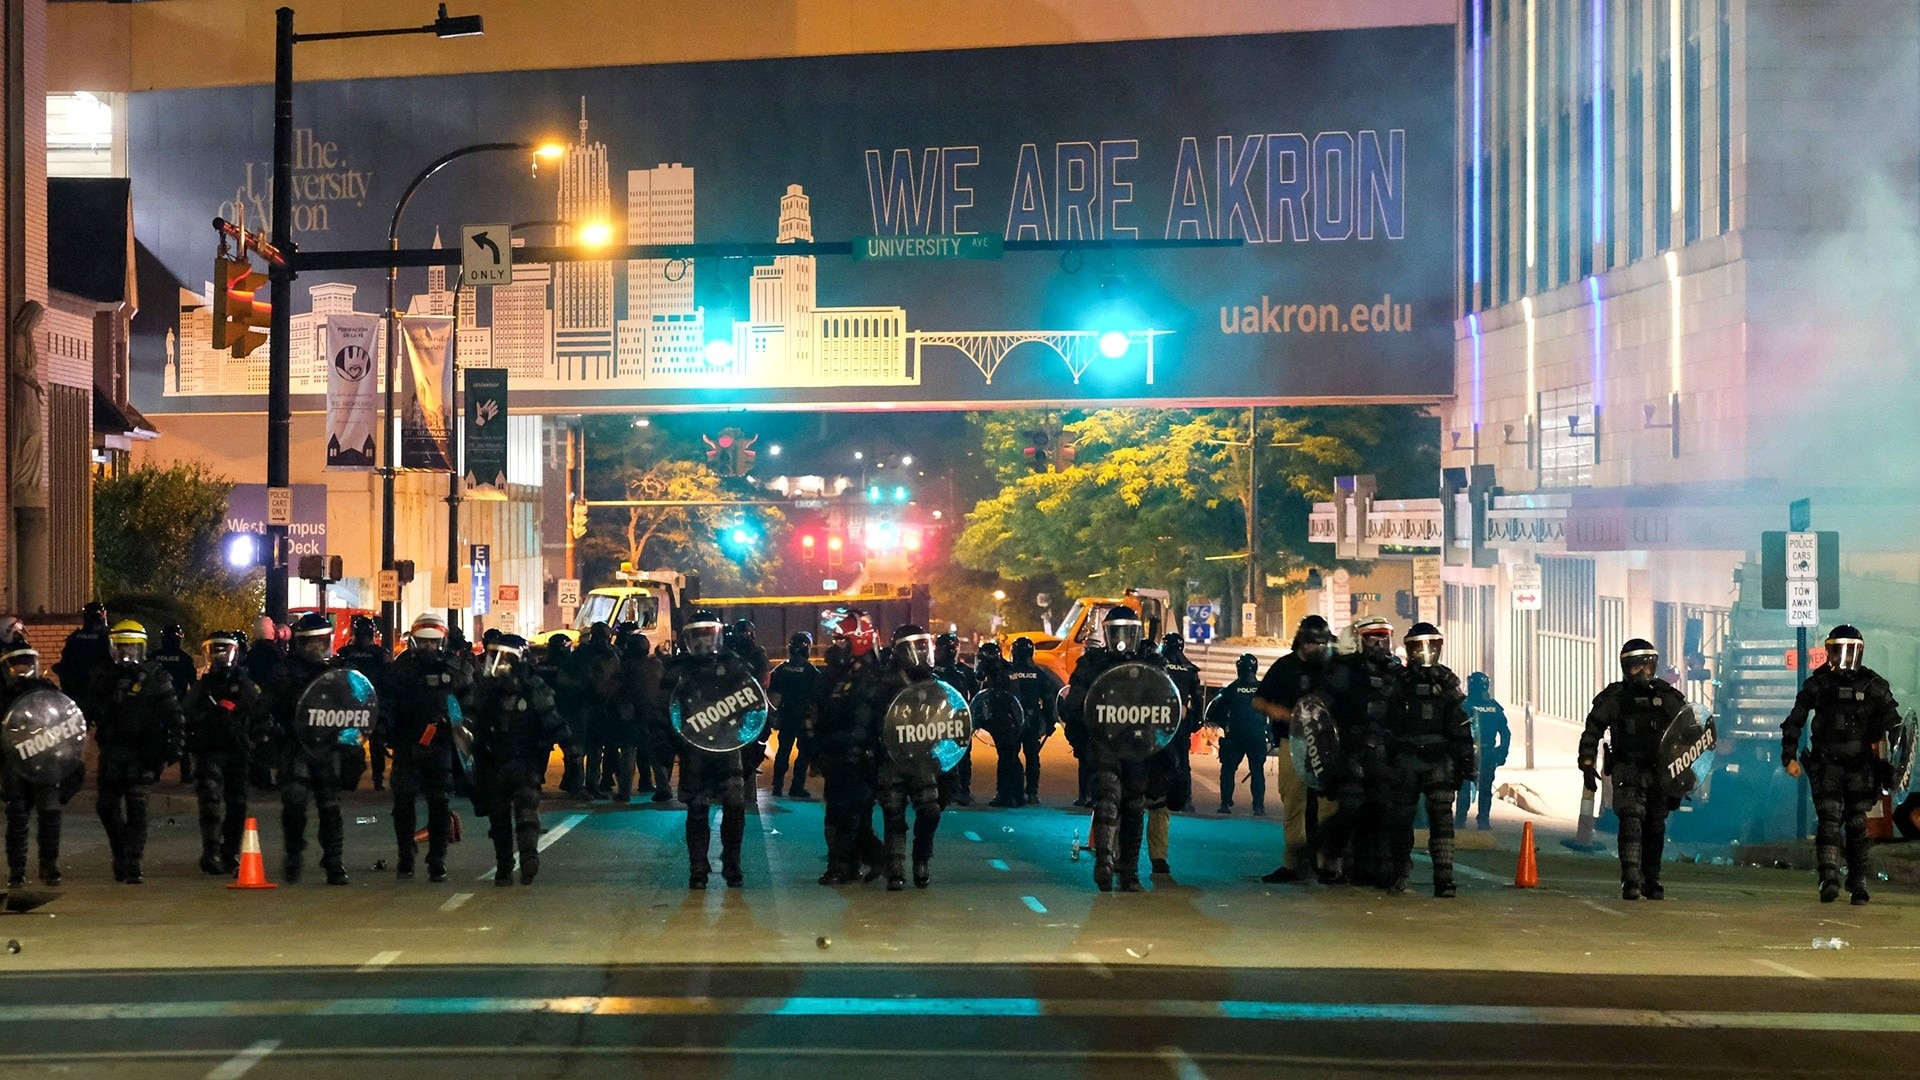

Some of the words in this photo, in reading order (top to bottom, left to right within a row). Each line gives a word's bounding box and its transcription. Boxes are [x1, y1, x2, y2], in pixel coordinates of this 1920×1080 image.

[293, 128, 338, 169] The
[245, 162, 372, 207] Uversity
[865, 146, 979, 235] WE
[1005, 140, 1138, 241] ARE
[1164, 129, 1405, 243] AKRON
[247, 197, 329, 233] Aon
[868, 237, 961, 257] UNIVERSITY
[972, 237, 989, 247] AVE
[471, 270, 505, 280] ONLY
[1220, 294, 1412, 334] uakron.edu
[228, 518, 264, 534] West
[287, 522, 326, 538] mpus
[1789, 540, 1814, 549] POLICE
[1792, 552, 1811, 560] CARS
[1793, 563, 1811, 572] ONLY
[475, 546, 486, 614] ENTER
[560, 593, 577, 604] 25
[1794, 587, 1811, 596] TOW
[1190, 607, 1209, 618] 76
[1791, 600, 1813, 608] AWAY
[1792, 611, 1813, 620] ZONE
[1236, 686, 1258, 694] POLIC
[308, 708, 370, 728] TROOPER
[686, 686, 759, 733] TROOPER
[1096, 704, 1171, 724] TROOPER
[1473, 705, 1497, 713] POLICE
[15, 713, 81, 761] TROOPER
[896, 719, 965, 743] TROOPER
[1667, 727, 1714, 780] TROOPER
